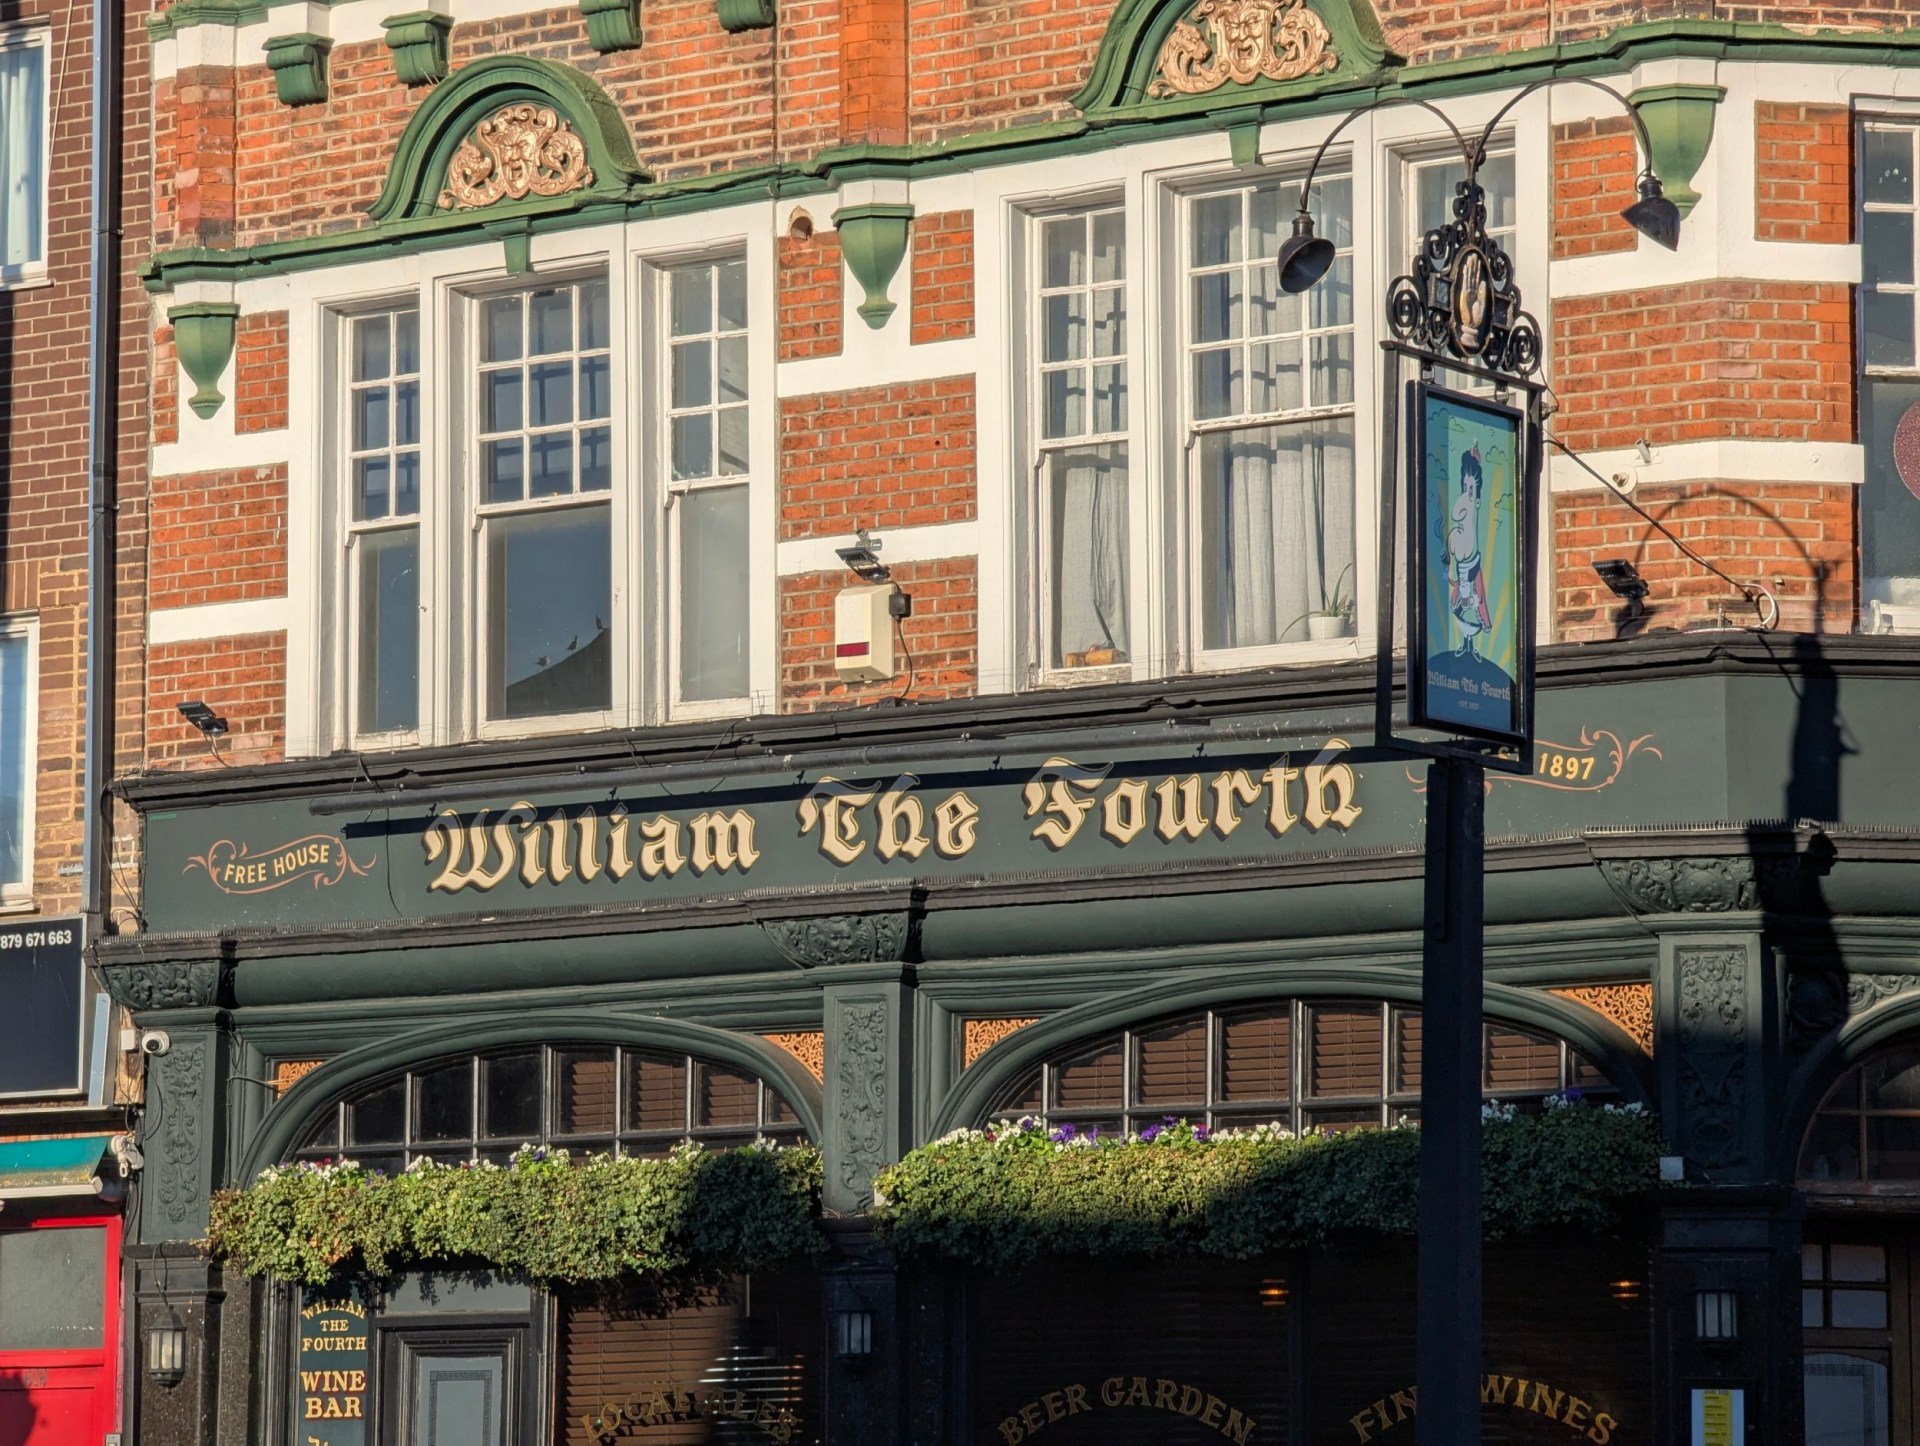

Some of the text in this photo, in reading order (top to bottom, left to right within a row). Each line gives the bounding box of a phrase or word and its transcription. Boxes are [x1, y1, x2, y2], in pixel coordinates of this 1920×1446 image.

[1427, 670, 1460, 690] William
[1481, 681, 1511, 701] Fourth
[1538, 752, 1595, 780] 1897
[422, 737, 1363, 892] William The Fourth
[224, 844, 330, 884] FREE HOUSE
[0, 929, 72, 950] 879 671 663
[320, 1319, 349, 1332] THE
[302, 1336, 367, 1352] FOURTH
[301, 1370, 366, 1393] WINE
[304, 1396, 363, 1419] BAR
[580, 1383, 799, 1444] LOCAL ALES
[997, 1376, 1256, 1446] BEER GARDEN
[1350, 1374, 1618, 1445] FIN WINES
